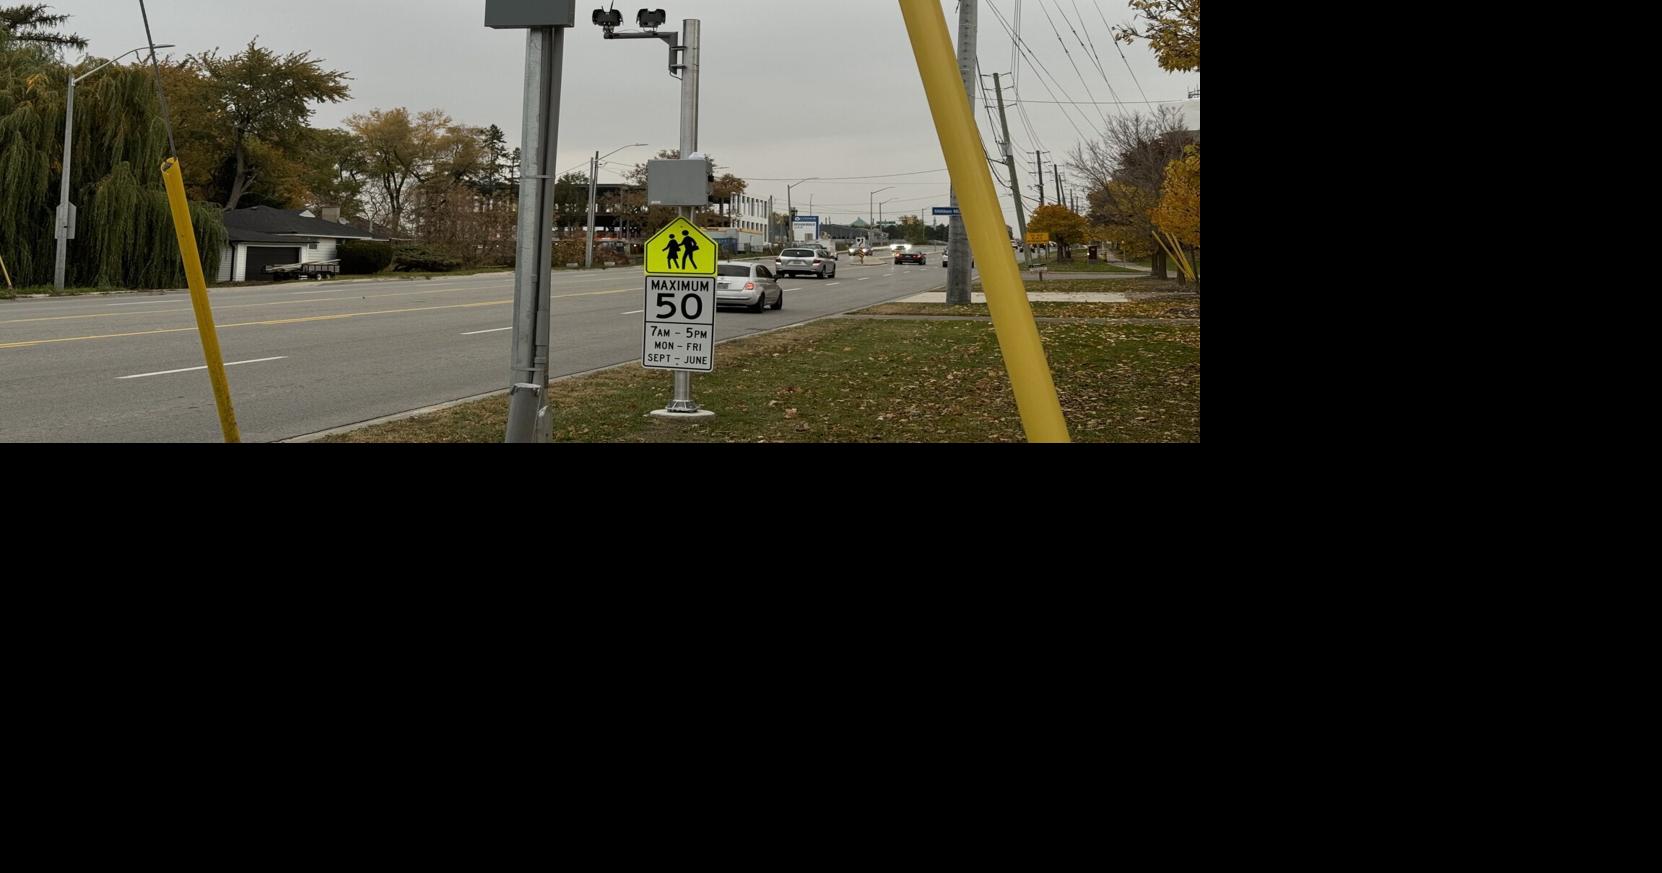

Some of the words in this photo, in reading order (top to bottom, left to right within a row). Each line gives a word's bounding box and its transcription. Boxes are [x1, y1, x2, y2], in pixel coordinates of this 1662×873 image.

[651, 279, 709, 292] MAXIMUM
[655, 292, 703, 320] 50
[650, 325, 670, 337] 7AM
[686, 327, 707, 339] 5PM
[654, 341, 674, 350] MON
[686, 342, 702, 351] FRI
[647, 353, 671, 362] SEPT
[684, 356, 708, 365] JUNE
